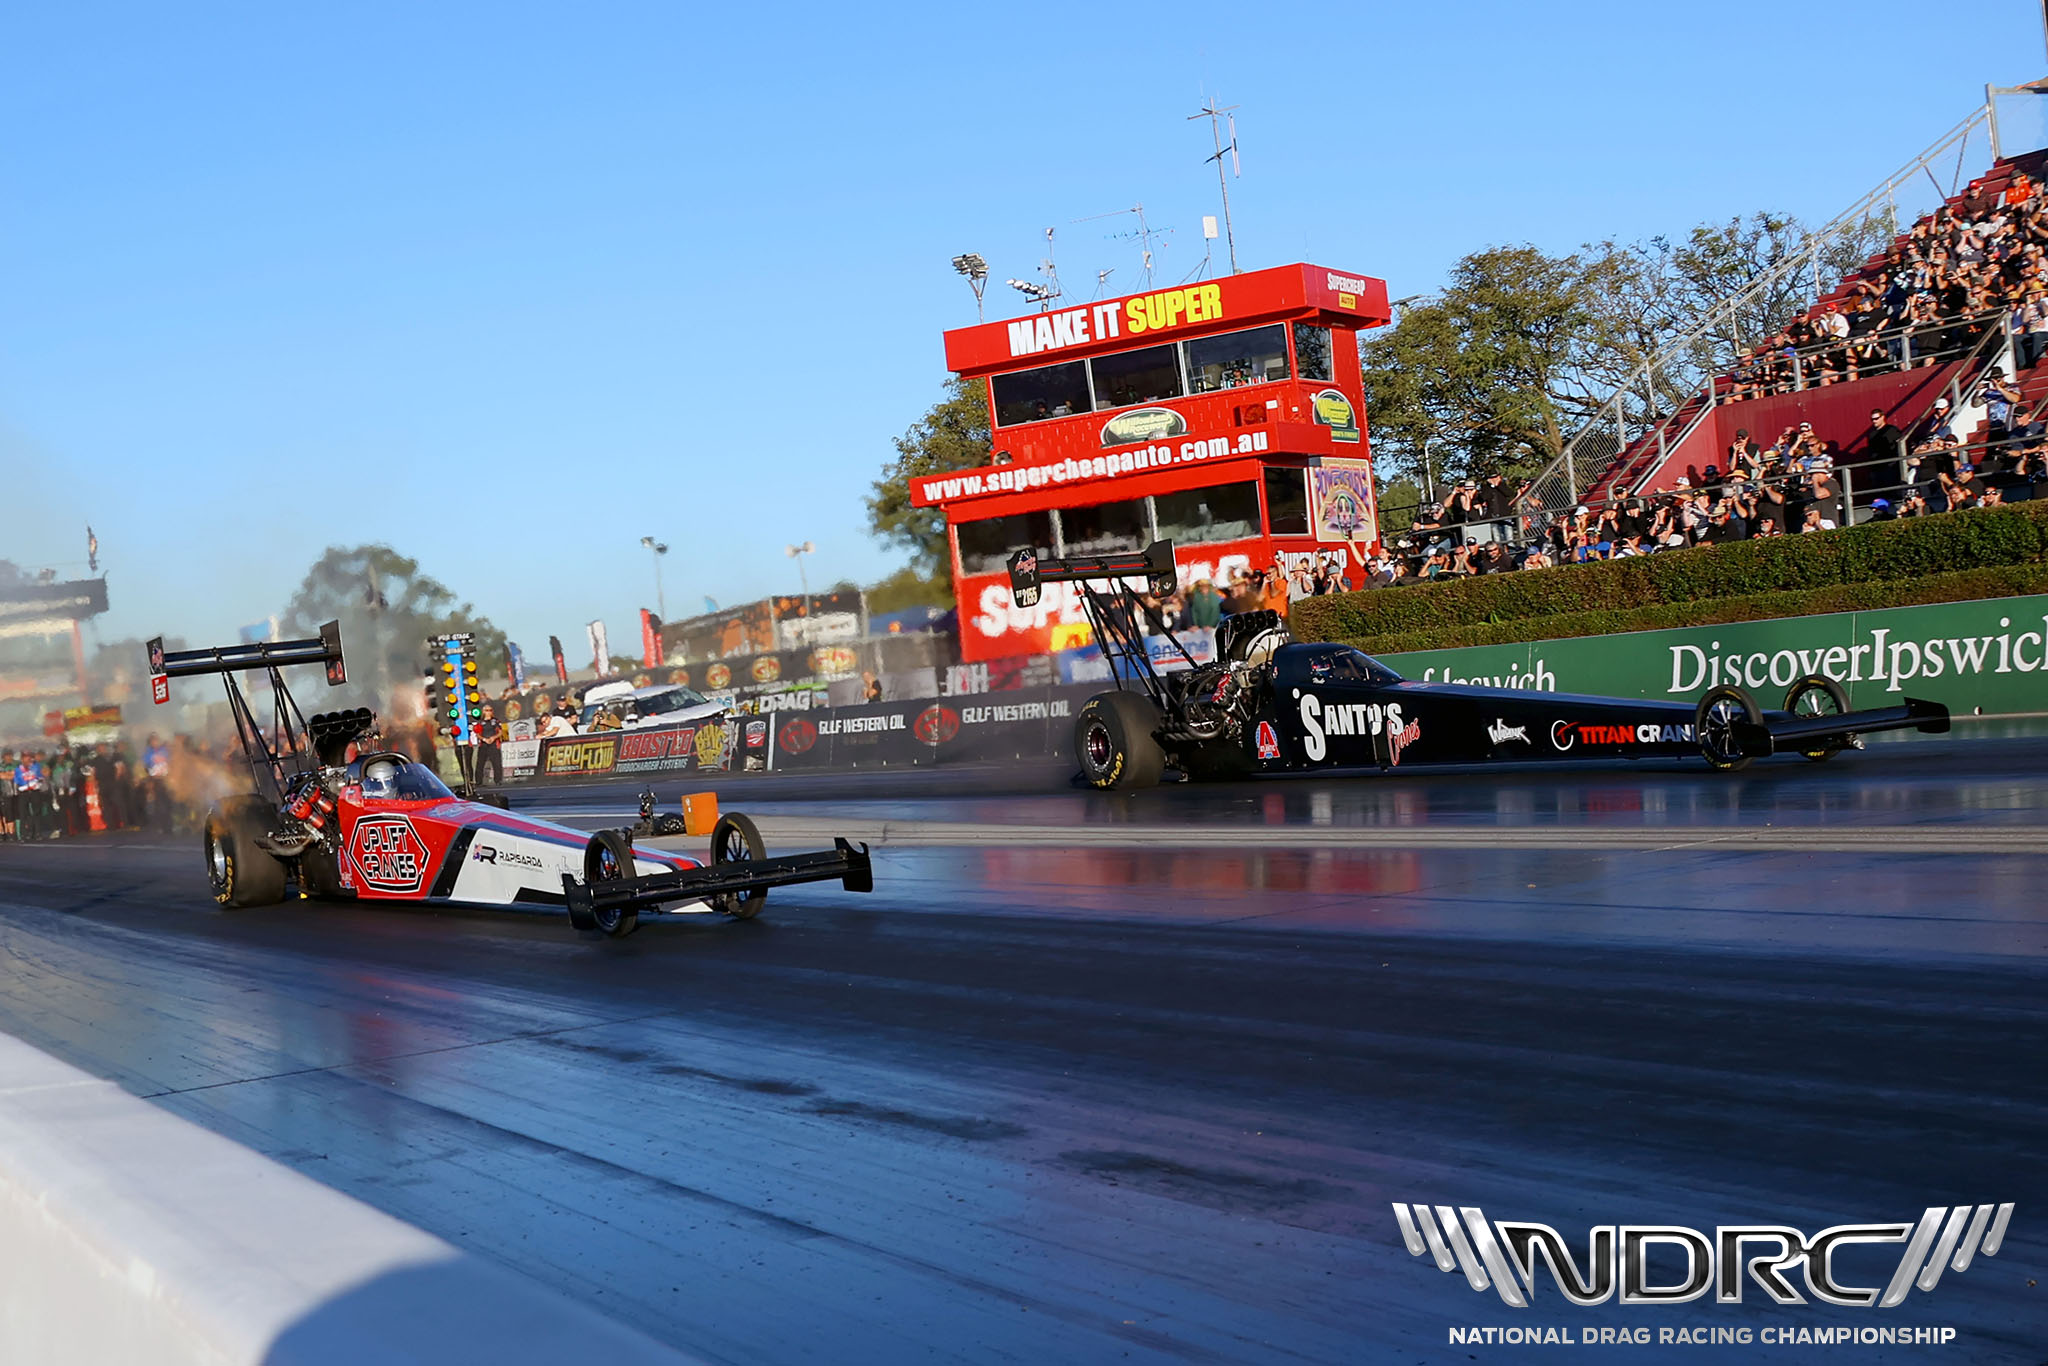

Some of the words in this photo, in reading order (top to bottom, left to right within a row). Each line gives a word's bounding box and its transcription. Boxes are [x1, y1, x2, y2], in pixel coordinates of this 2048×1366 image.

[1327, 272, 1366, 296] SUPERCHEAP
[1007, 308, 1090, 357] MAKE
[1092, 302, 1121, 341] IT
[1125, 283, 1223, 334] SUPER
[923, 430, 1268, 501] www.supercheapauto.com.au
[1667, 611, 2048, 693] DiscoverIpswic
[758, 689, 812, 714] DRAG
[962, 706, 992, 724] GULF
[991, 702, 1049, 722] WESTERN
[1049, 699, 1072, 717] OIL
[818, 718, 843, 735] GULF
[843, 715, 889, 734] WESTERN
[889, 713, 907, 730] OIL
[1577, 725, 1635, 745] TITAN
[1636, 723, 1696, 743] CRAN
[617, 727, 695, 762] BOOSTED
[659, 758, 689, 770] SYSTEMS
[360, 825, 409, 853] UPLIFT
[362, 853, 418, 880] CRANES
[499, 851, 544, 868] RAPISARDA
